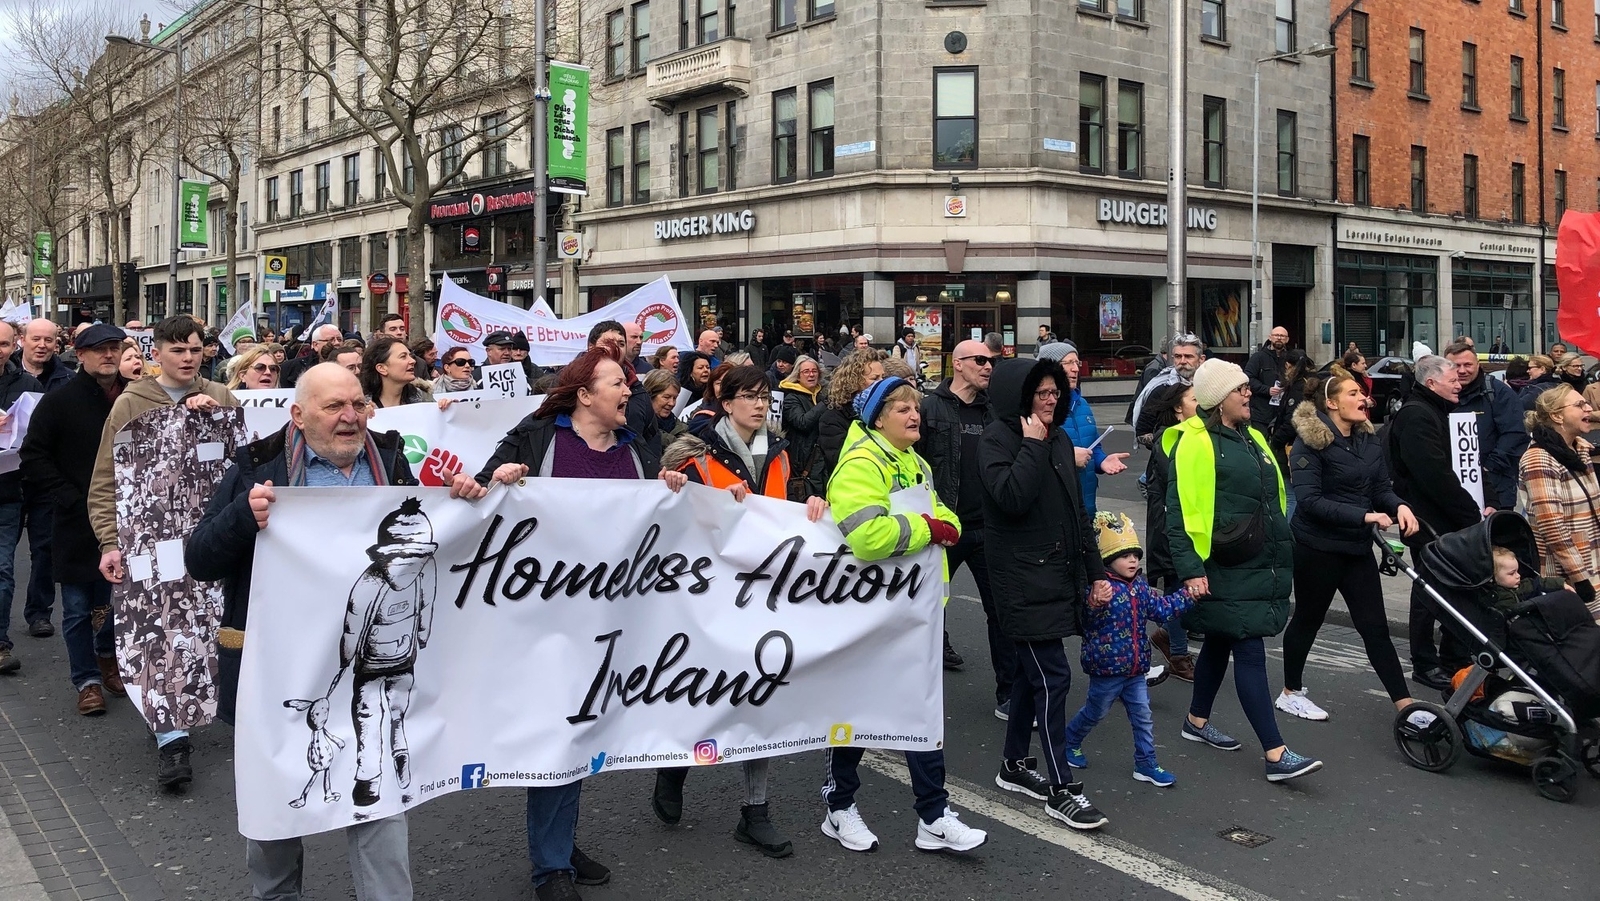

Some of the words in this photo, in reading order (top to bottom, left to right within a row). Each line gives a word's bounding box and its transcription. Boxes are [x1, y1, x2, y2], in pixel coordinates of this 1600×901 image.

[1099, 198, 1167, 226] BURGER
[1188, 207, 1217, 230] ING
[654, 215, 710, 240] BURGER
[713, 209, 755, 235] KING
[1480, 242, 1505, 252] Central
[1508, 244, 1535, 254] Revenue
[512, 280, 534, 289] BURGER
[641, 305, 660, 316] Before
[660, 304, 675, 318] Profit
[906, 309, 915, 325] 2
[129, 336, 154, 344] ICK
[486, 324, 534, 342] PPE
[647, 330, 675, 344] Alliance
[489, 369, 517, 382] KICK
[1457, 422, 1479, 437] KIC
[1458, 438, 1478, 452] OU
[1459, 453, 1474, 468] FF
[1461, 469, 1478, 484] FG
[449, 513, 716, 609] Homeless
[734, 534, 926, 612] Action
[566, 629, 795, 726] Ireland
[420, 781, 434, 795] Find
[437, 779, 446, 789] us
[448, 776, 460, 786] on
[486, 763, 589, 781] homelessactionireland
[605, 752, 689, 767] @irelandhomeless
[722, 734, 827, 759] @homelessactionireland
[854, 732, 929, 743] protesthomeless
